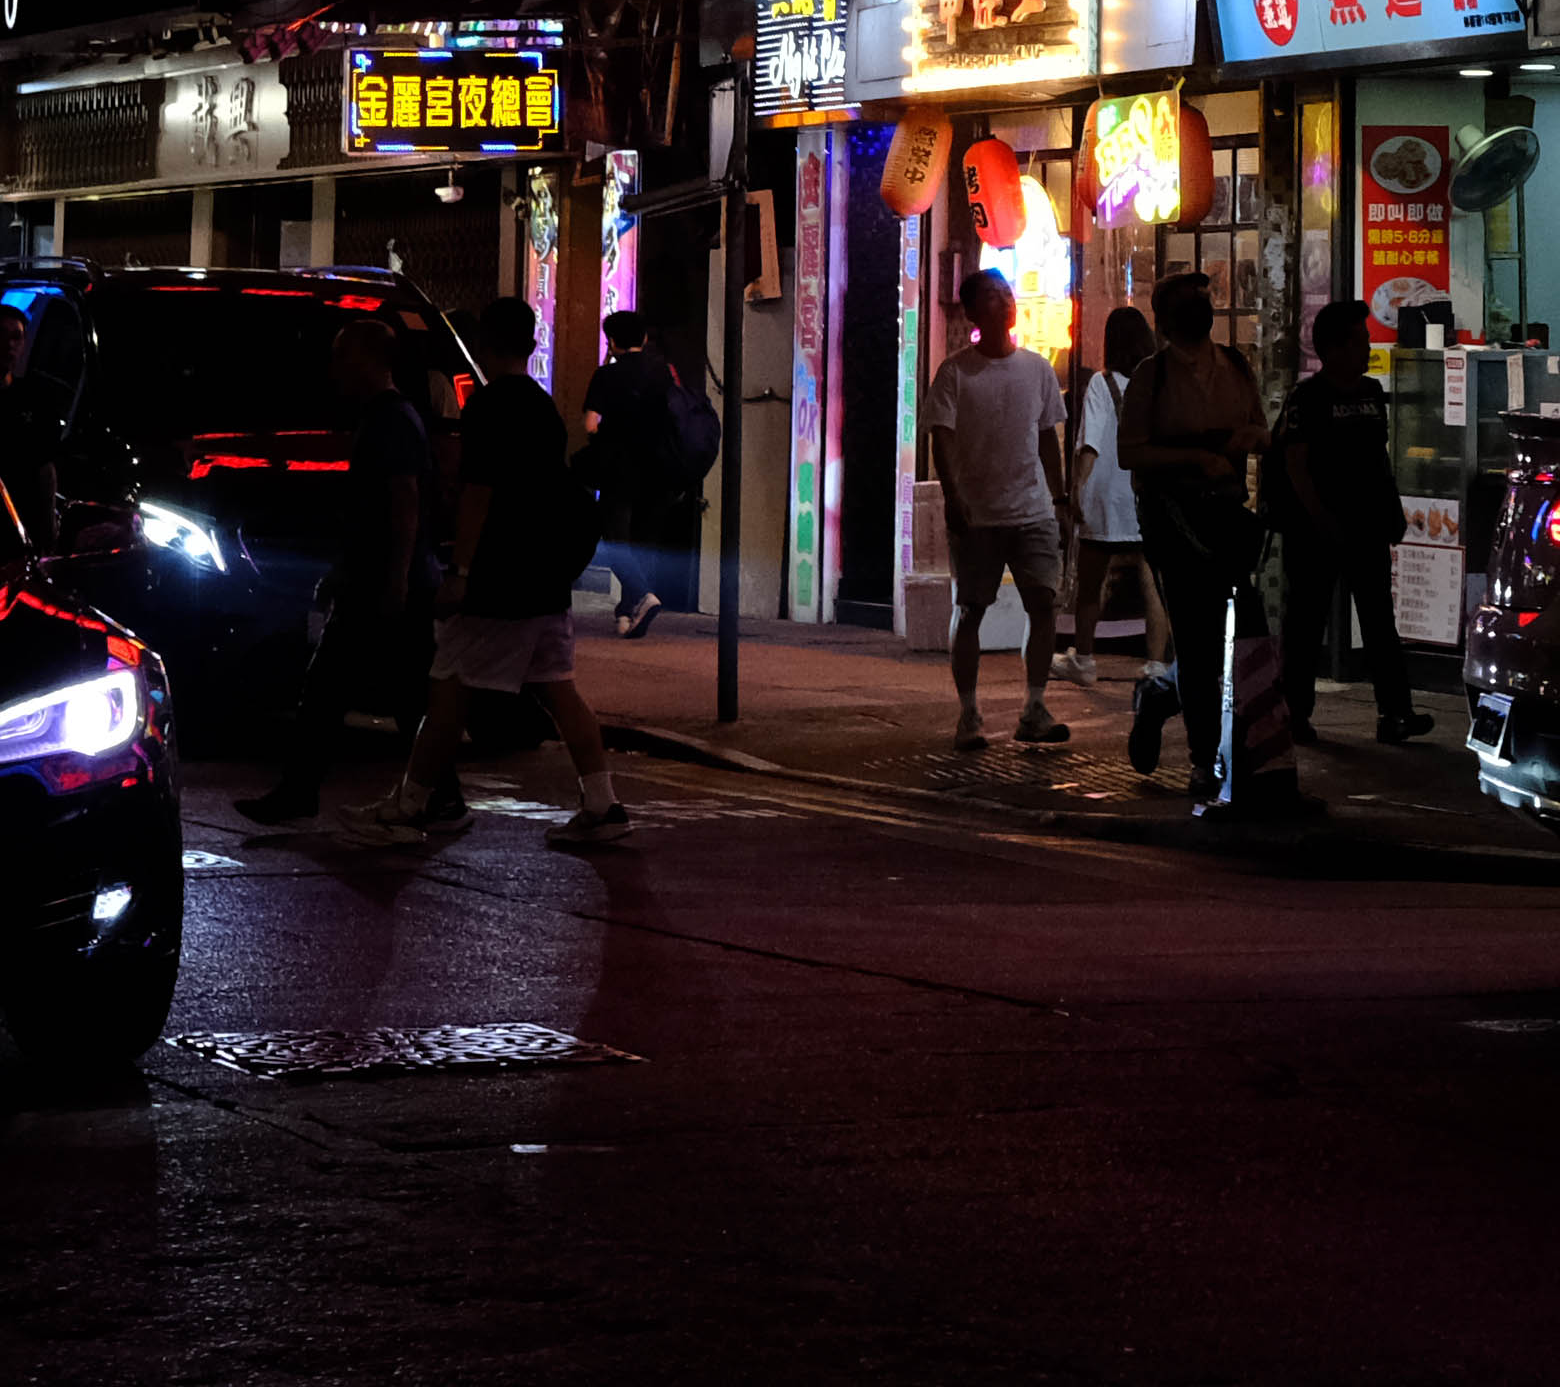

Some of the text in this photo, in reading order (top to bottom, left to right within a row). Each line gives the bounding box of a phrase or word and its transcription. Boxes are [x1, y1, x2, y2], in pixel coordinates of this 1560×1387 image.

[357, 75, 553, 128] 金麗宮夜總會
[1368, 203, 1444, 222] 即叫即做
